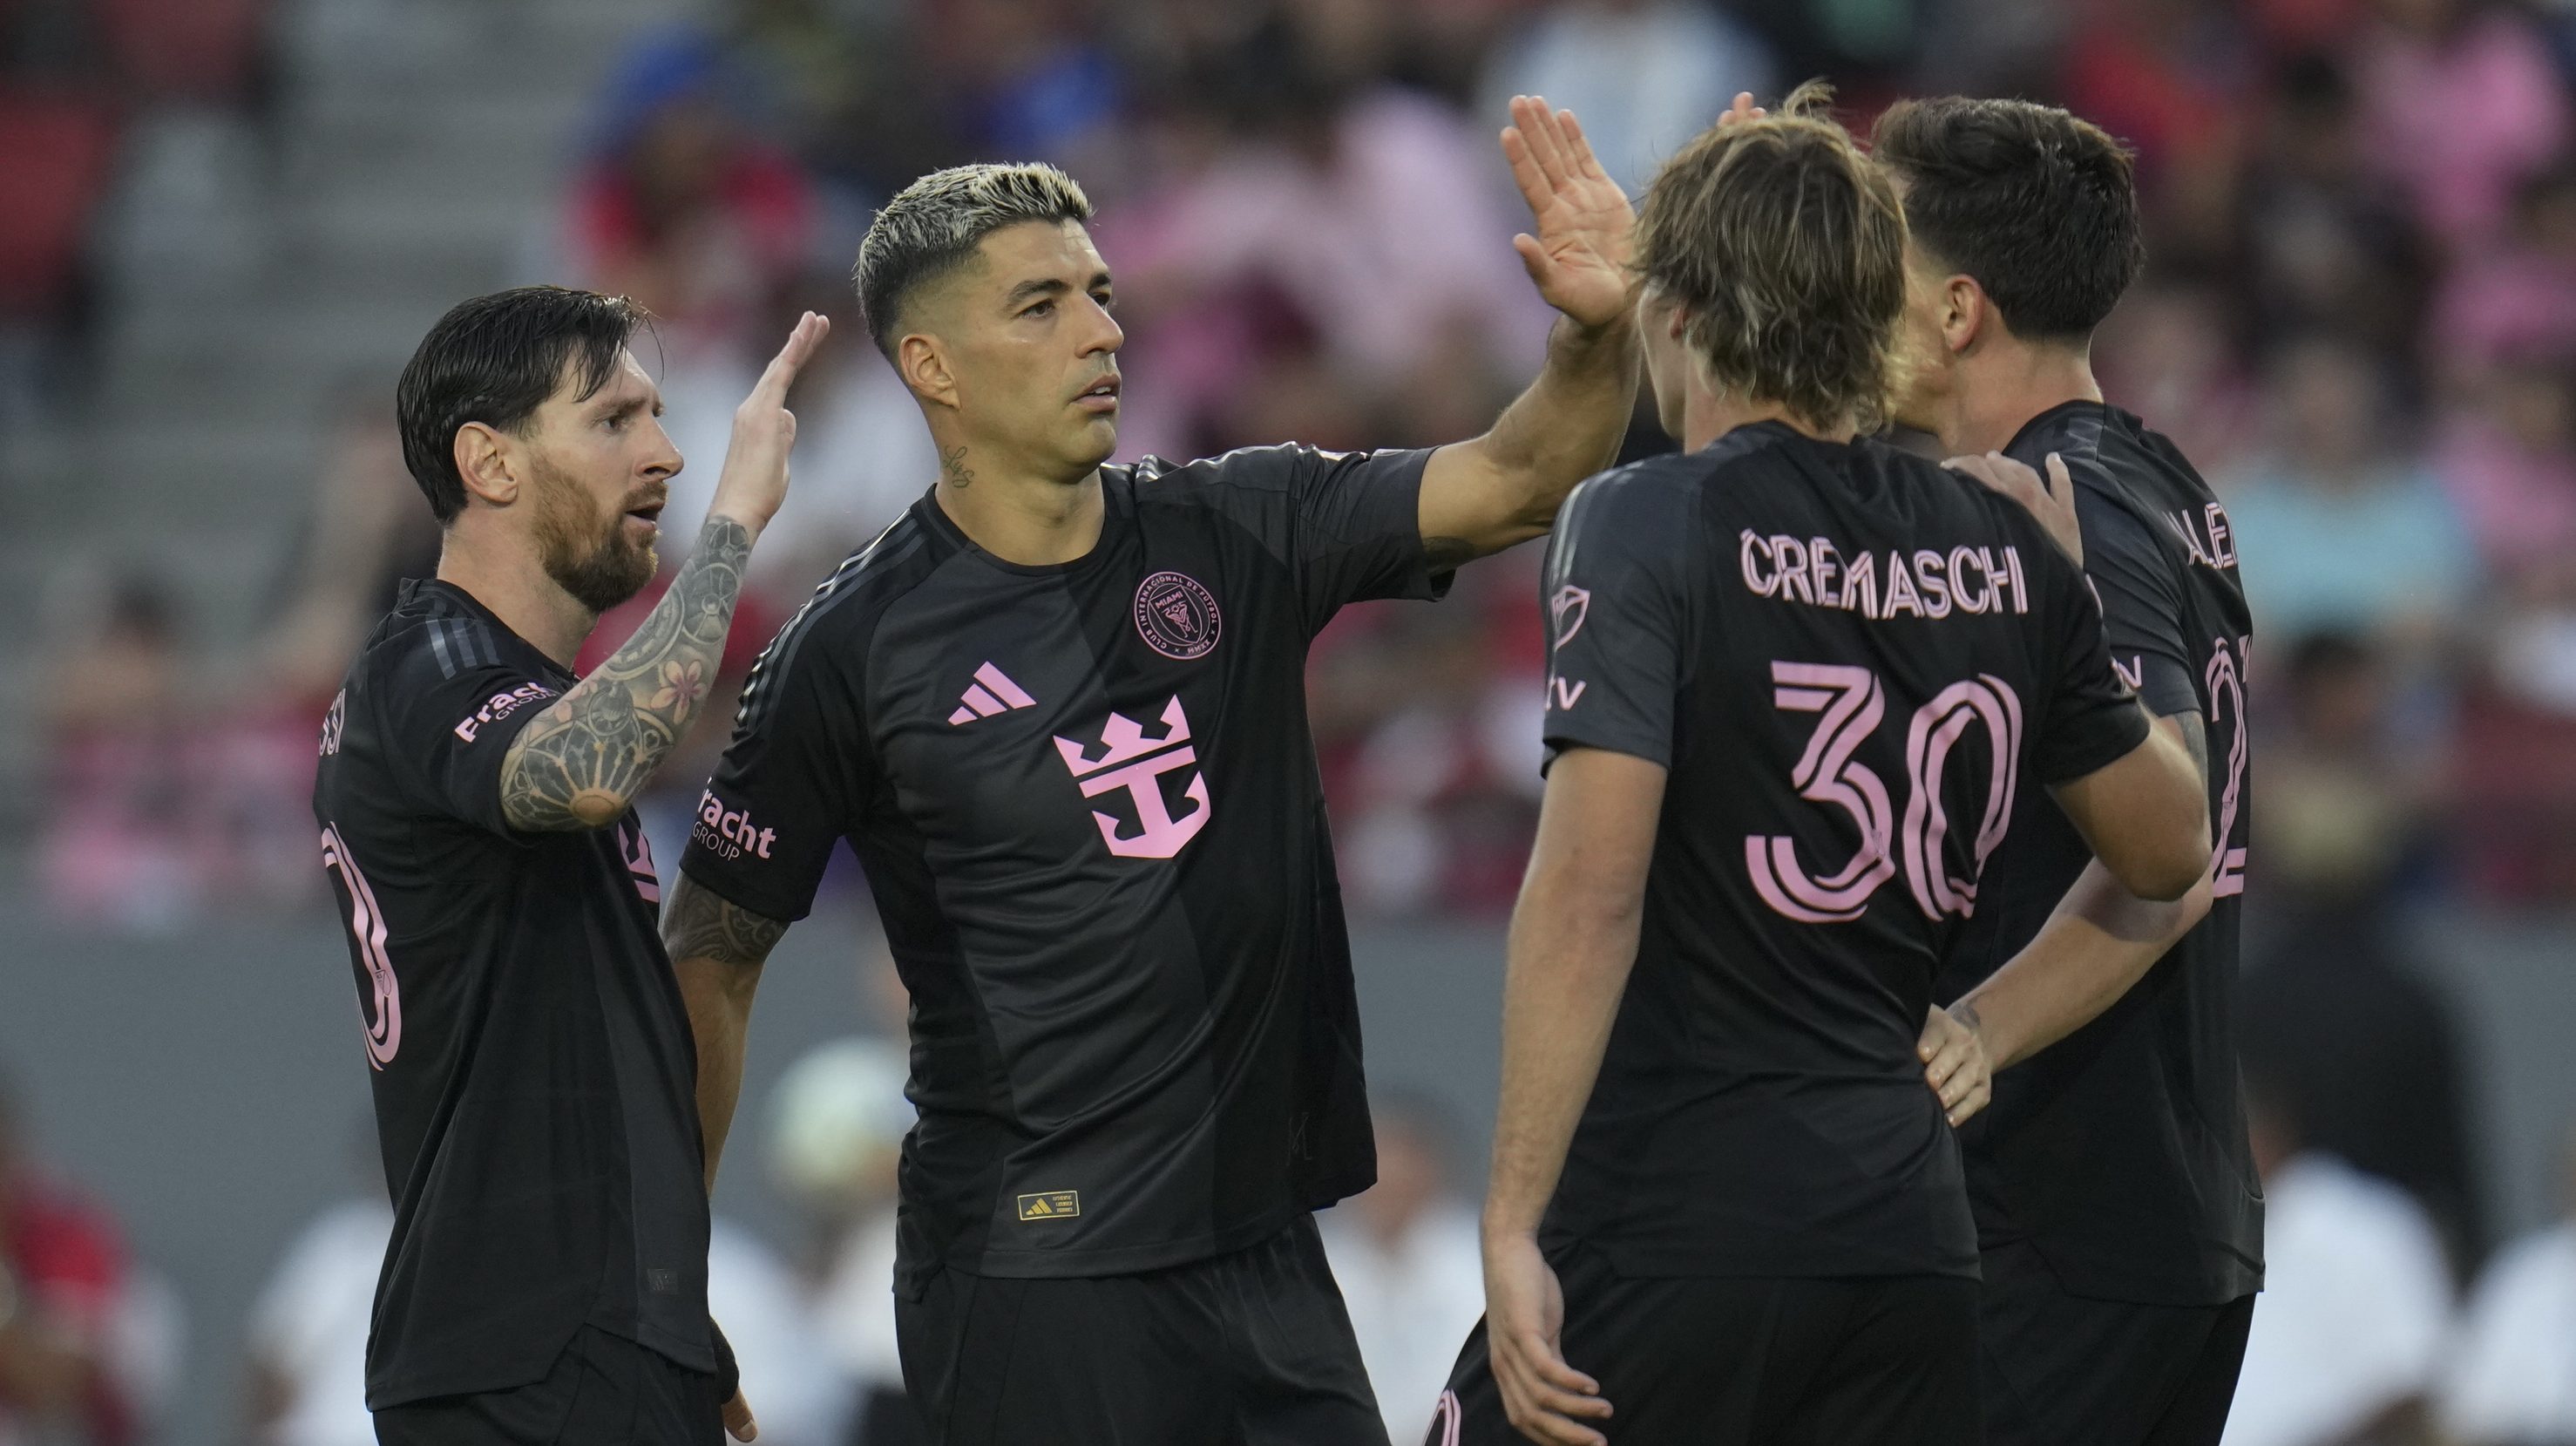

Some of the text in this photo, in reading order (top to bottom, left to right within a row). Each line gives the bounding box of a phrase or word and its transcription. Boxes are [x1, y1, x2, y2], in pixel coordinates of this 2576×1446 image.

[1138, 575, 1183, 627] INTERNACIONAL
[1155, 590, 1183, 609] MIAMI
[1186, 581, 1198, 591] DE
[1145, 628, 1168, 649] CLUB
[1746, 660, 2024, 924] 30
[697, 776, 777, 859] racht
[692, 821, 740, 861] GROUP
